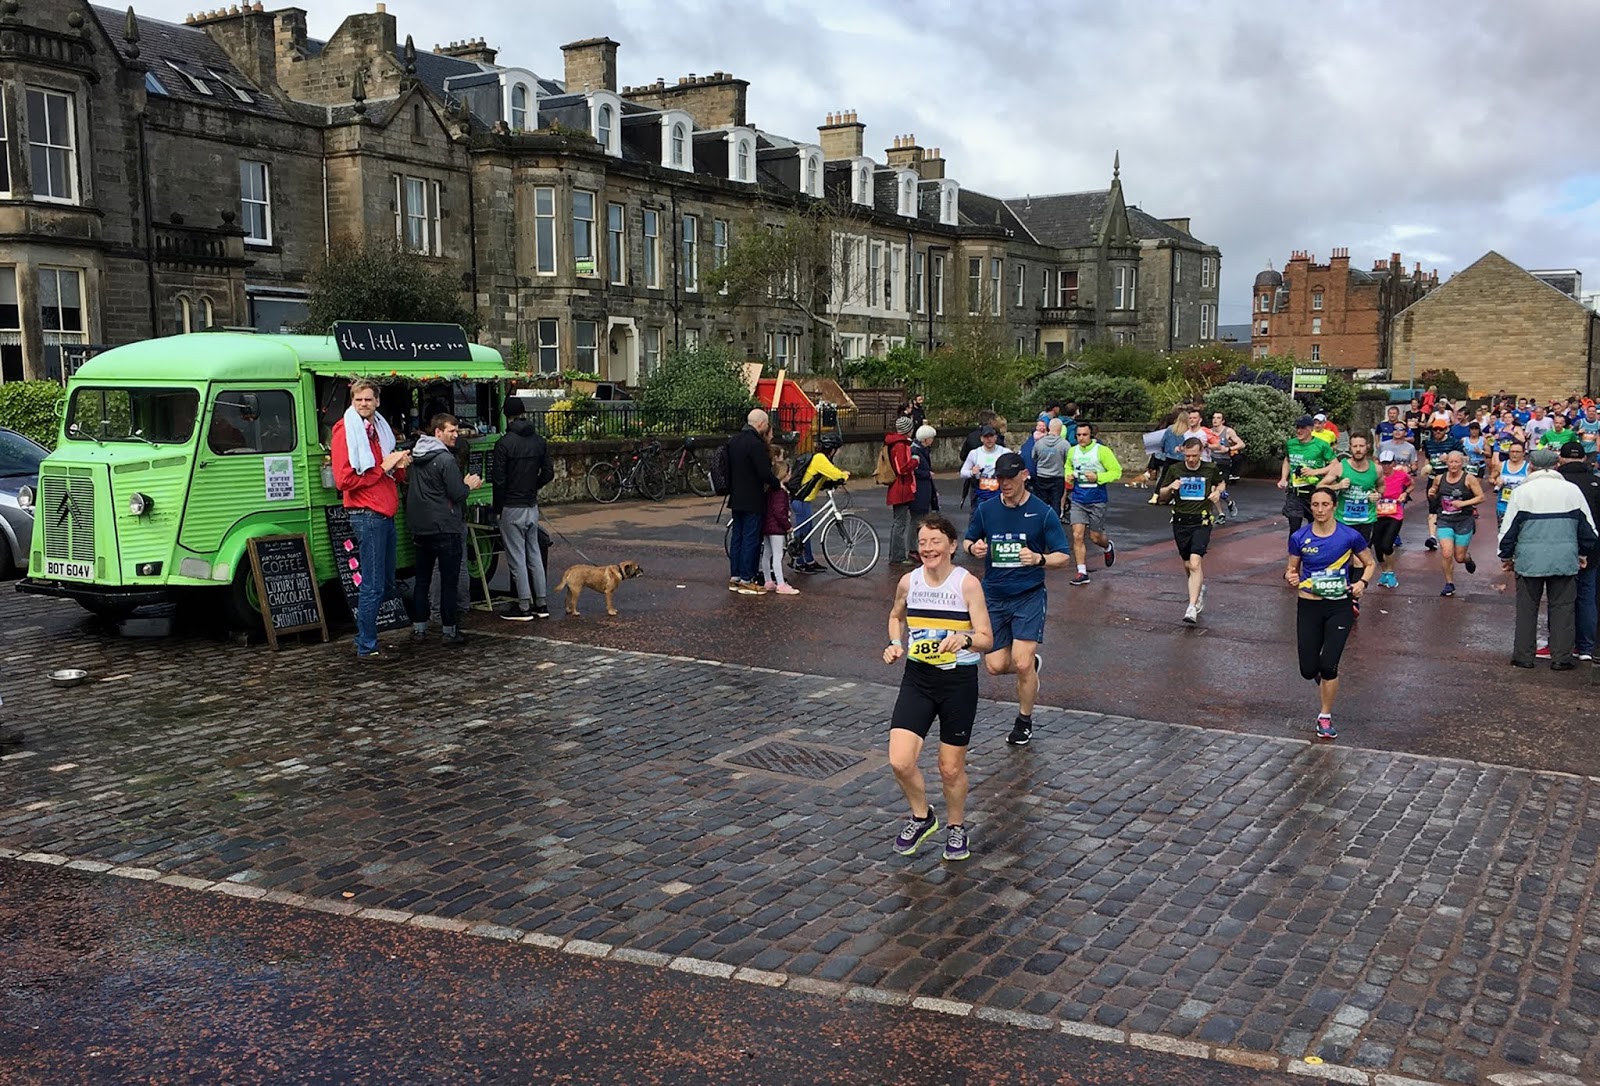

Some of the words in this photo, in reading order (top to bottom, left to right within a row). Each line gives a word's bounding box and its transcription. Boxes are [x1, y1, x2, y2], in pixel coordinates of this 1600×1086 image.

[342, 329, 366, 350] the
[368, 329, 406, 350] little
[411, 342, 441, 358] green
[996, 543, 1021, 552] 4513
[48, 562, 64, 574] BOT
[262, 558, 305, 574] COFFEE
[265, 580, 295, 594] LUXURY
[297, 577, 311, 589] HOT
[1316, 581, 1343, 589] 18656
[268, 589, 312, 606] CHOCOLATE
[913, 591, 956, 600] PORTOBELLO
[303, 609, 319, 622] TEA
